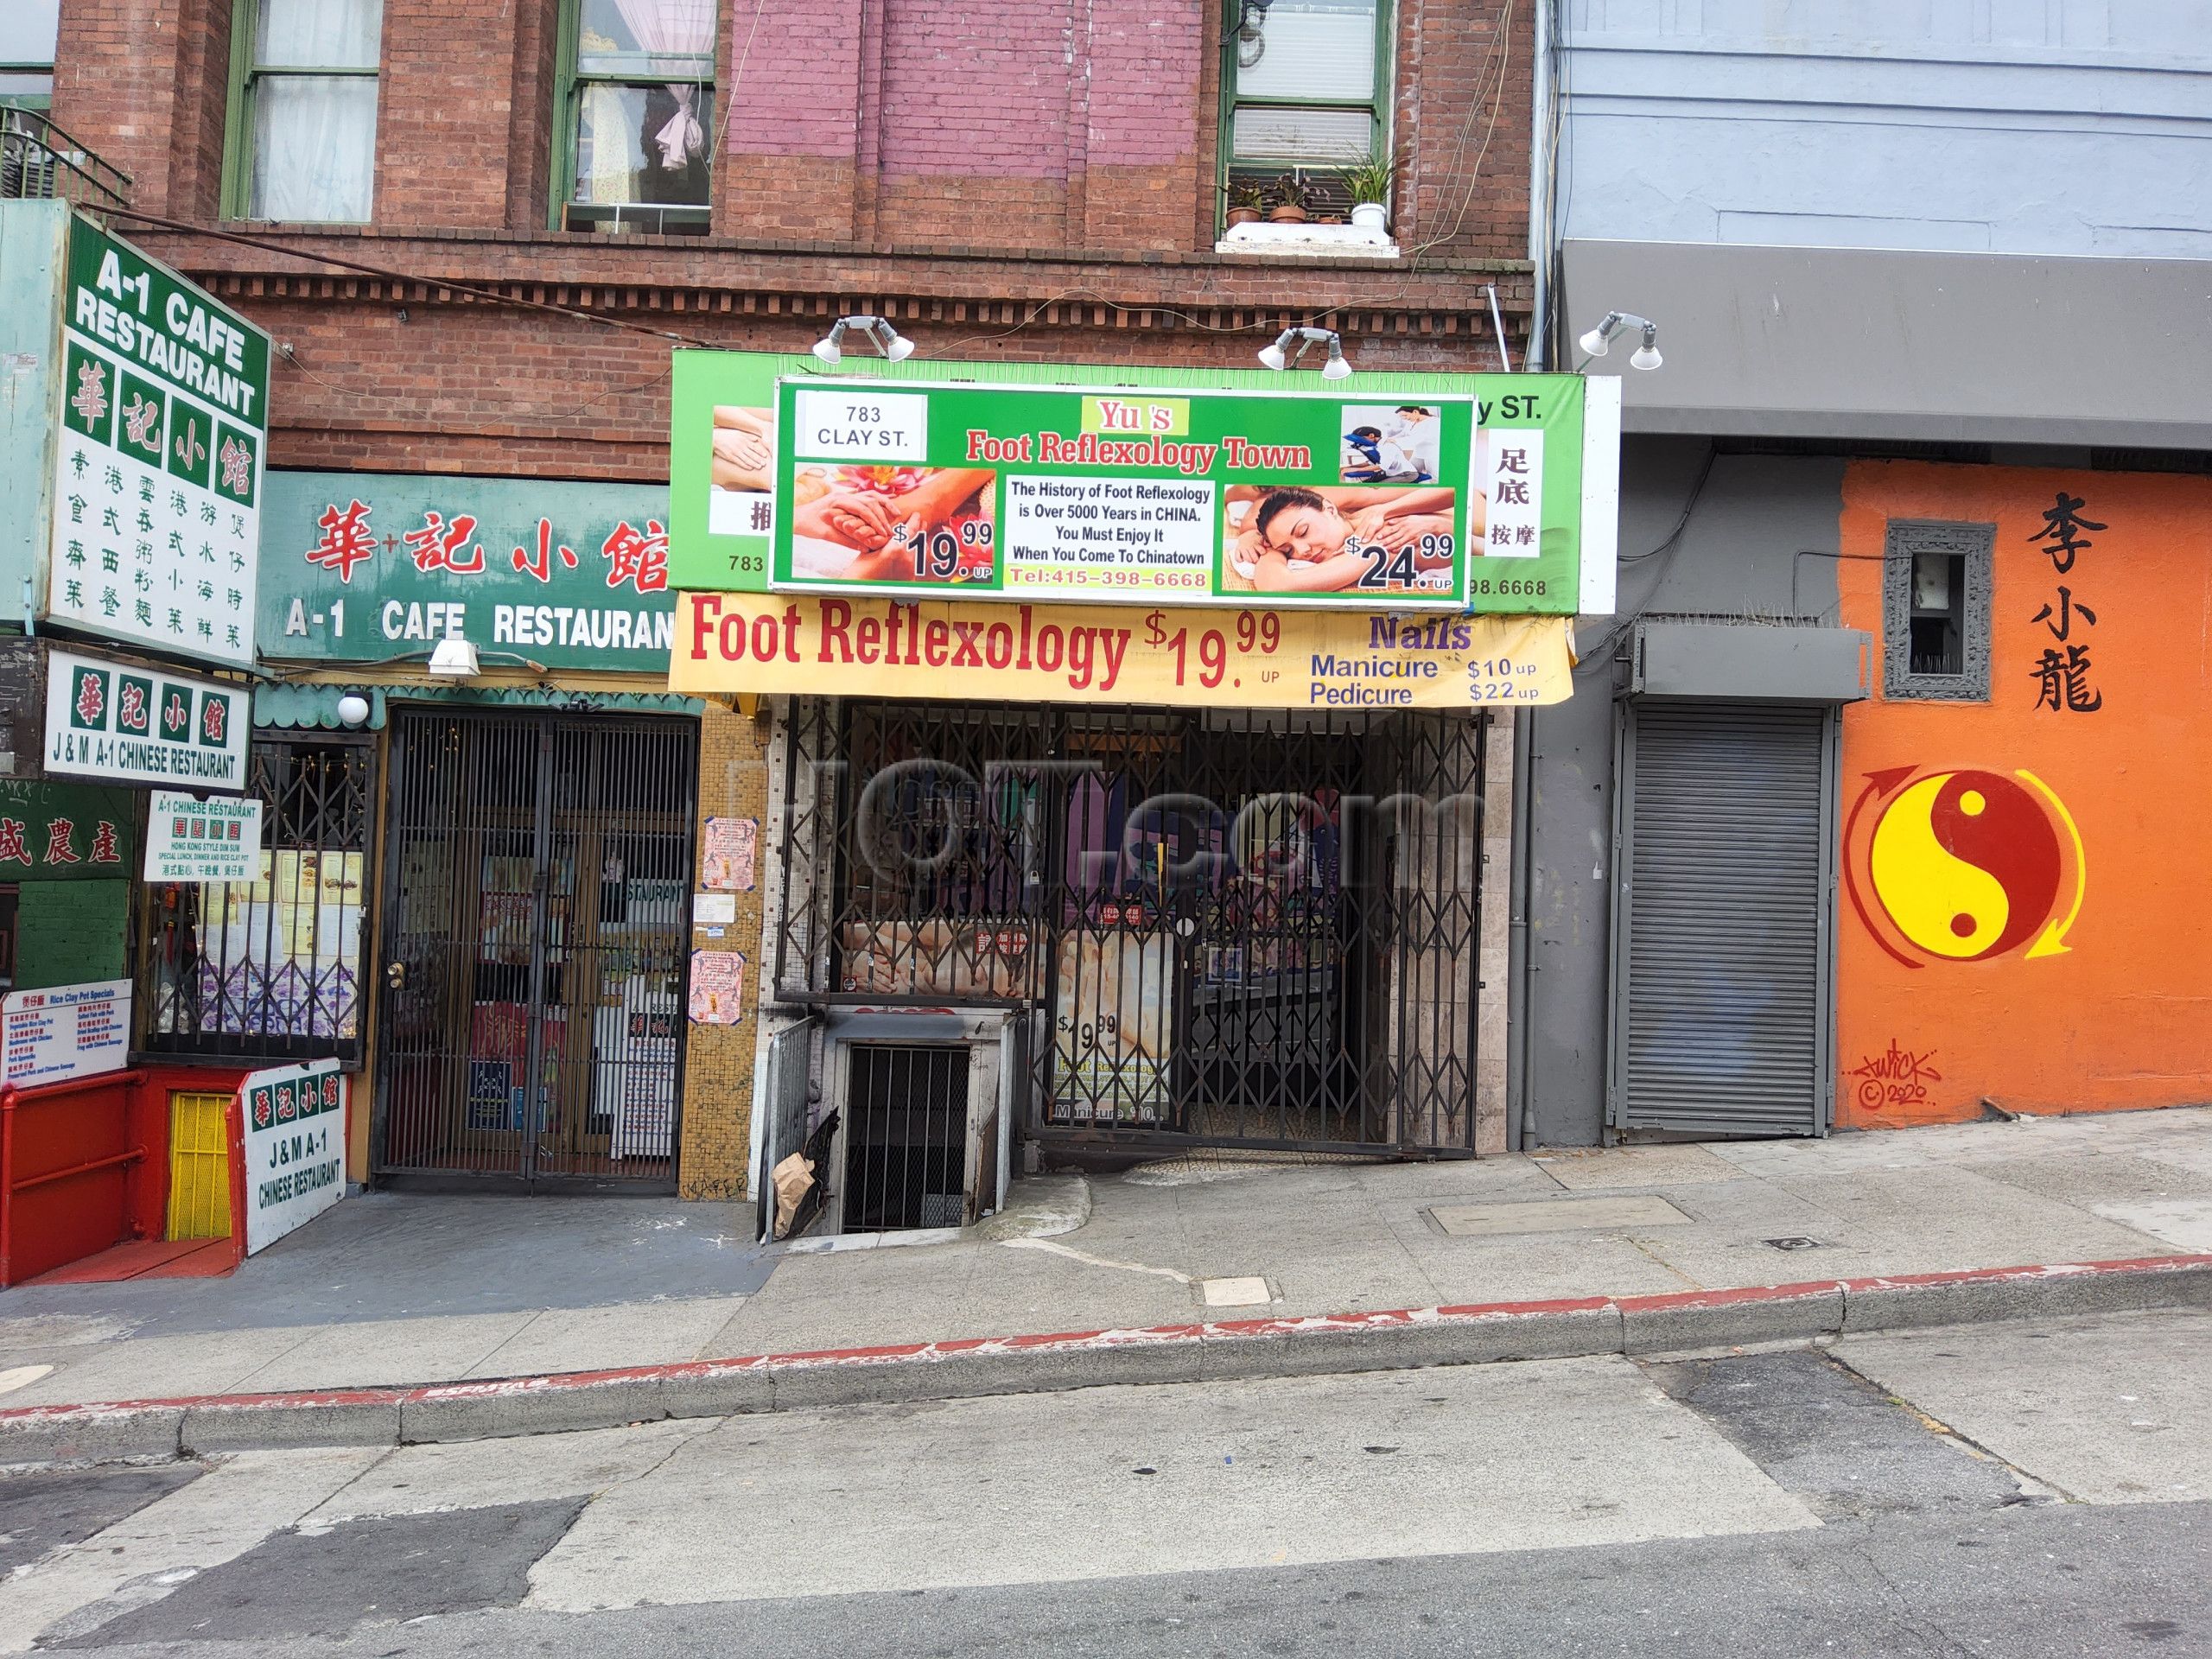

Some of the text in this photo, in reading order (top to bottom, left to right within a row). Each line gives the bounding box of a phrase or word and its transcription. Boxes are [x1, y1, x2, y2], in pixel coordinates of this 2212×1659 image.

[96, 249, 246, 368] A-1 CAFE
[76, 286, 255, 416] RESTAURANT
[846, 406, 881, 423] 783
[1501, 395, 1541, 419] ST.
[72, 359, 253, 496] 華記小館
[817, 429, 909, 448] CLAY ST.
[966, 429, 1312, 474] Foot Reflexology Town
[1495, 448, 1530, 505] 足底
[1012, 481, 1211, 504] The History of Foot Reflexology
[1019, 503, 1200, 522] is Over 5000 Years in CHINA.
[1055, 525, 1164, 545] You Must Enjoy It
[1491, 524, 1535, 546] 按摩
[728, 556, 764, 572] 783
[1014, 546, 1205, 564] When You Come To Chinatown
[973, 567, 992, 579] UP
[1010, 569, 1206, 588] Tel:415-398-6668
[1434, 579, 1452, 589] UP
[2027, 492, 2108, 713] 李小龍
[285, 598, 344, 637] A-1
[382, 599, 465, 640] CAFE
[690, 594, 802, 662] Foot
[818, 598, 1132, 691] Reflexology
[1262, 670, 1280, 683] UP
[1369, 616, 1471, 652] Nails
[1312, 654, 1536, 679] Manicure $10 up
[1310, 682, 1539, 706] Pedicure $22 up
[77, 672, 225, 741] 華記小館
[54, 733, 235, 779] J & M A-1 CHINESE RESTAURANT
[158, 799, 256, 818] A-1 CHINESE RESTAURANT
[171, 842, 186, 851] HONG
[188, 842, 201, 851] KONG
[203, 843, 218, 852] STYLE
[50, 995, 63, 1004] Rice
[65, 993, 78, 1003] Clay
[79, 991, 90, 1001] Pot
[90, 988, 115, 1000] Specials
[255, 1075, 338, 1126] 華記小館
[258, 1159, 341, 1210] CHINESE RESTAURANT
